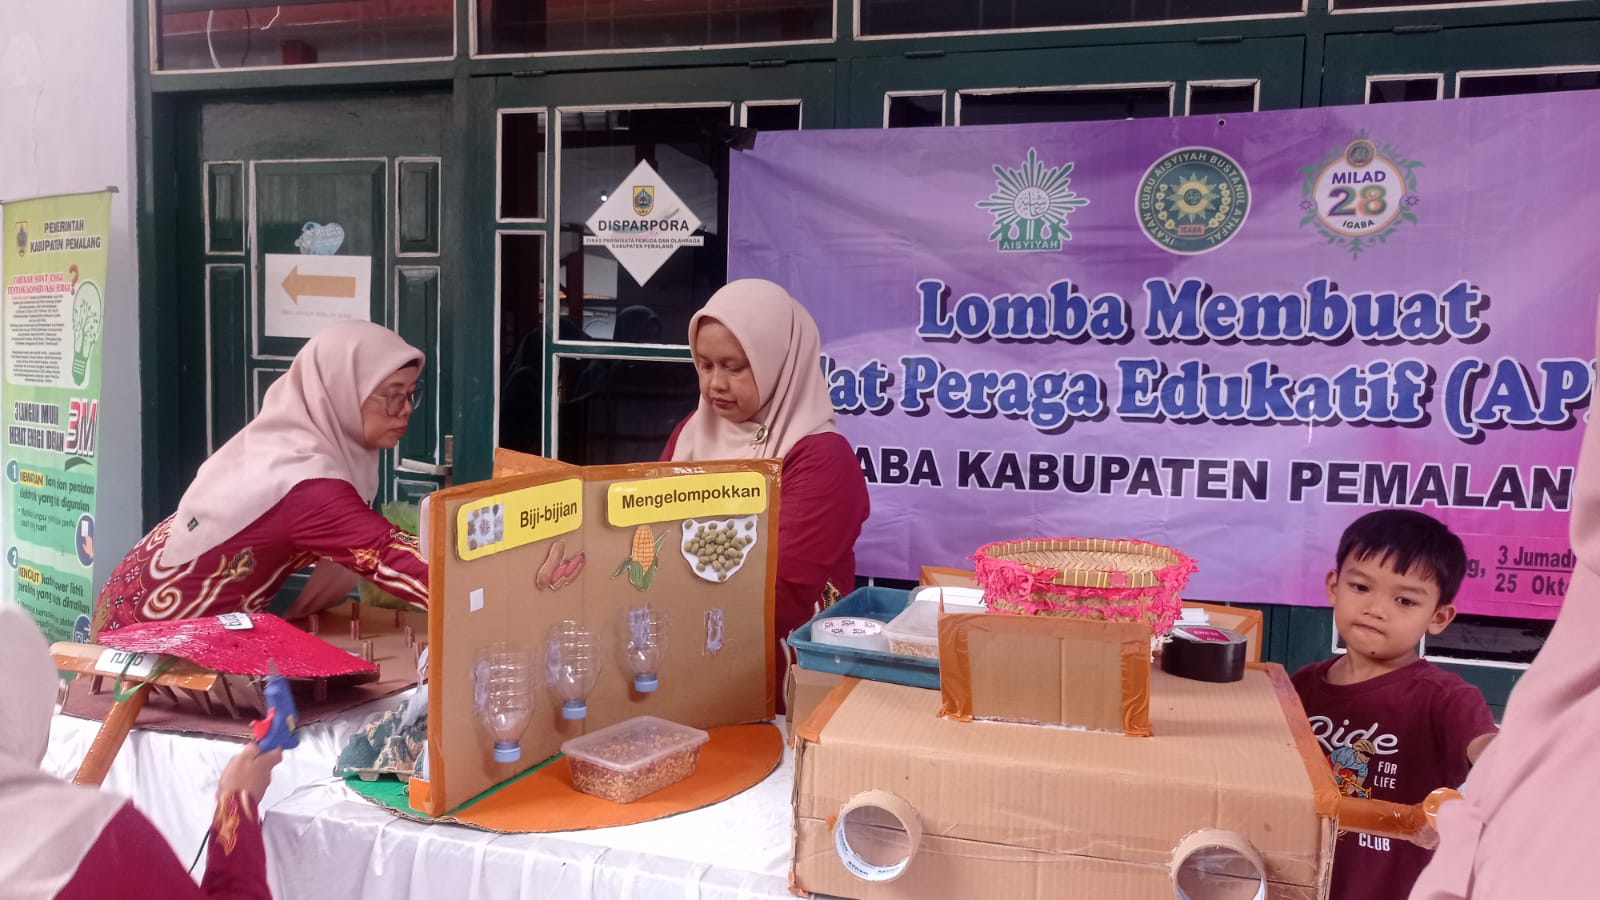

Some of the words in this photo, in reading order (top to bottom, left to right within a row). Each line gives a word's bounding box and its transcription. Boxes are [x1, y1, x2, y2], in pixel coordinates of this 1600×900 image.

[1154, 152, 1206, 177] AISYIYAH
[1332, 171, 1386, 184] MILAD
[1142, 178, 1156, 209] GURU
[1209, 155, 1245, 205] BUSTANUL
[1328, 184, 1387, 216] 28
[598, 219, 690, 231] DISPARPORA
[1143, 212, 1175, 245] IKATAN
[1206, 209, 1242, 244] ATHFAL
[1343, 219, 1375, 230] IGABA
[1002, 241, 1058, 249] AISYIYAH
[917, 279, 1129, 340] Lomba
[1144, 278, 1480, 341] Membuat
[900, 356, 1104, 429] Peraga
[1115, 358, 1427, 422] Edukatif
[1444, 357, 1596, 438] (AP
[66, 400, 97, 456] 3M
[957, 450, 1269, 501] KABUPATEN
[622, 484, 761, 510] Mengelompokkan
[519, 500, 578, 529] Biji-bijian
[1497, 545, 1508, 565] 3
[1495, 573, 1517, 593] 25
[1532, 575, 1568, 597] Okt
[1308, 715, 1399, 755] Ride
[1378, 761, 1398, 775] FOR
[1374, 775, 1397, 789] LIFE
[1358, 832, 1391, 852] CLUB
